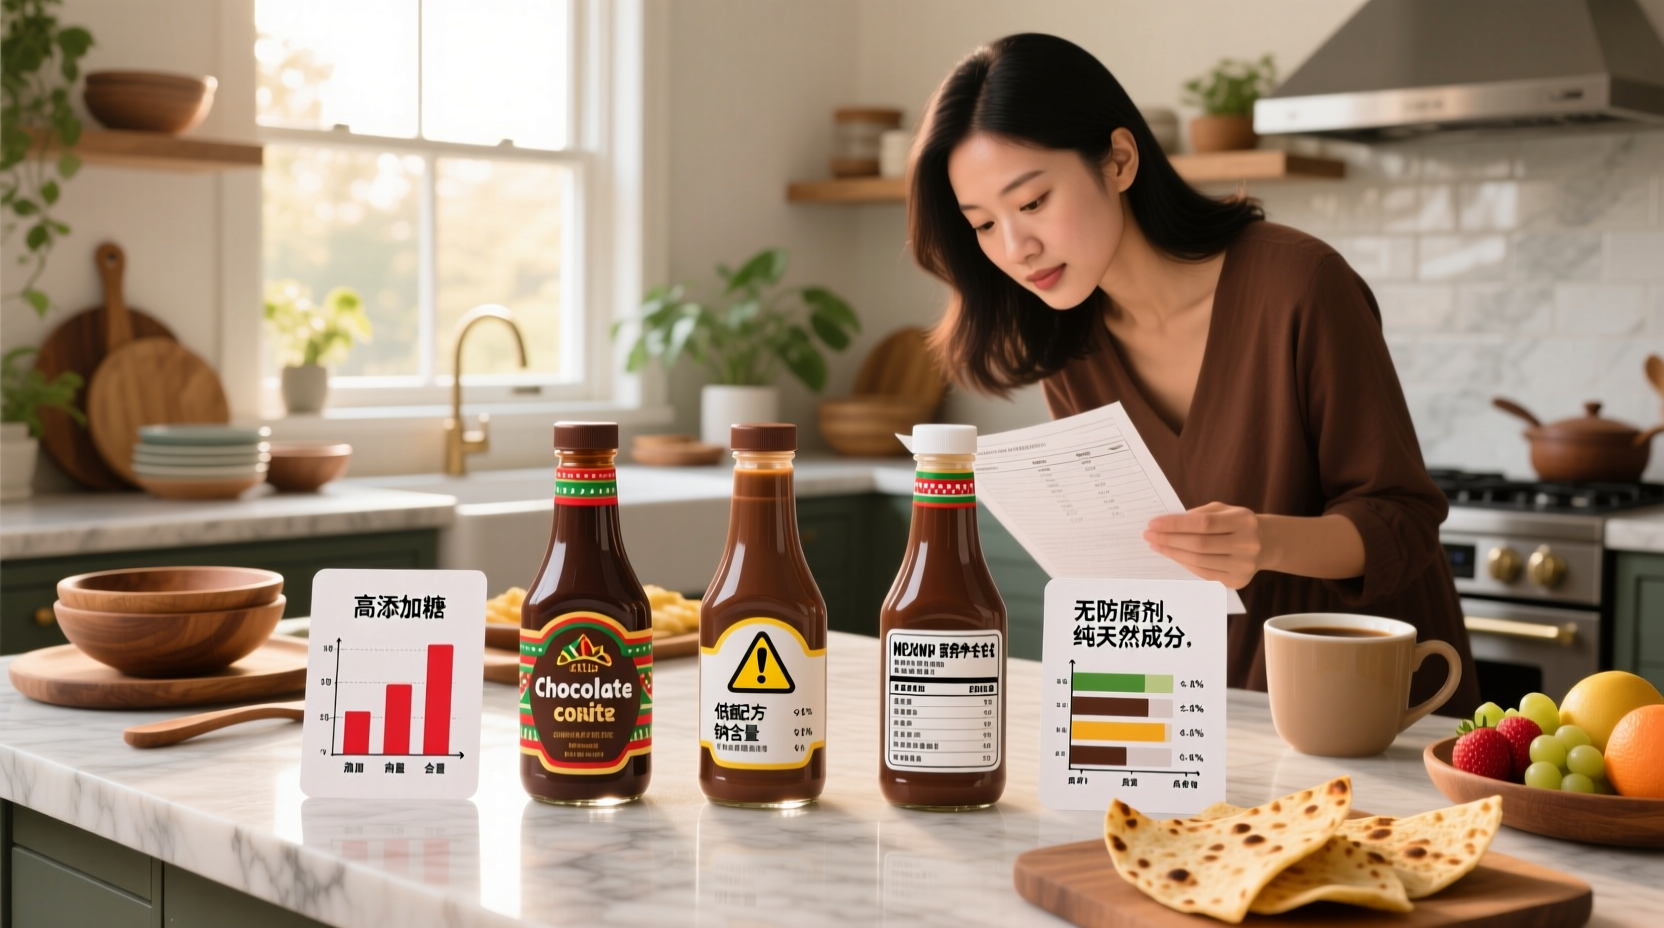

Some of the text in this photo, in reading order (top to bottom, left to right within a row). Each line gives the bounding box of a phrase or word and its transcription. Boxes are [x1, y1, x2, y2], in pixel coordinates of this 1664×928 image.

[354, 594, 446, 619] 高添加糖
[535, 676, 633, 699] Chocolate
